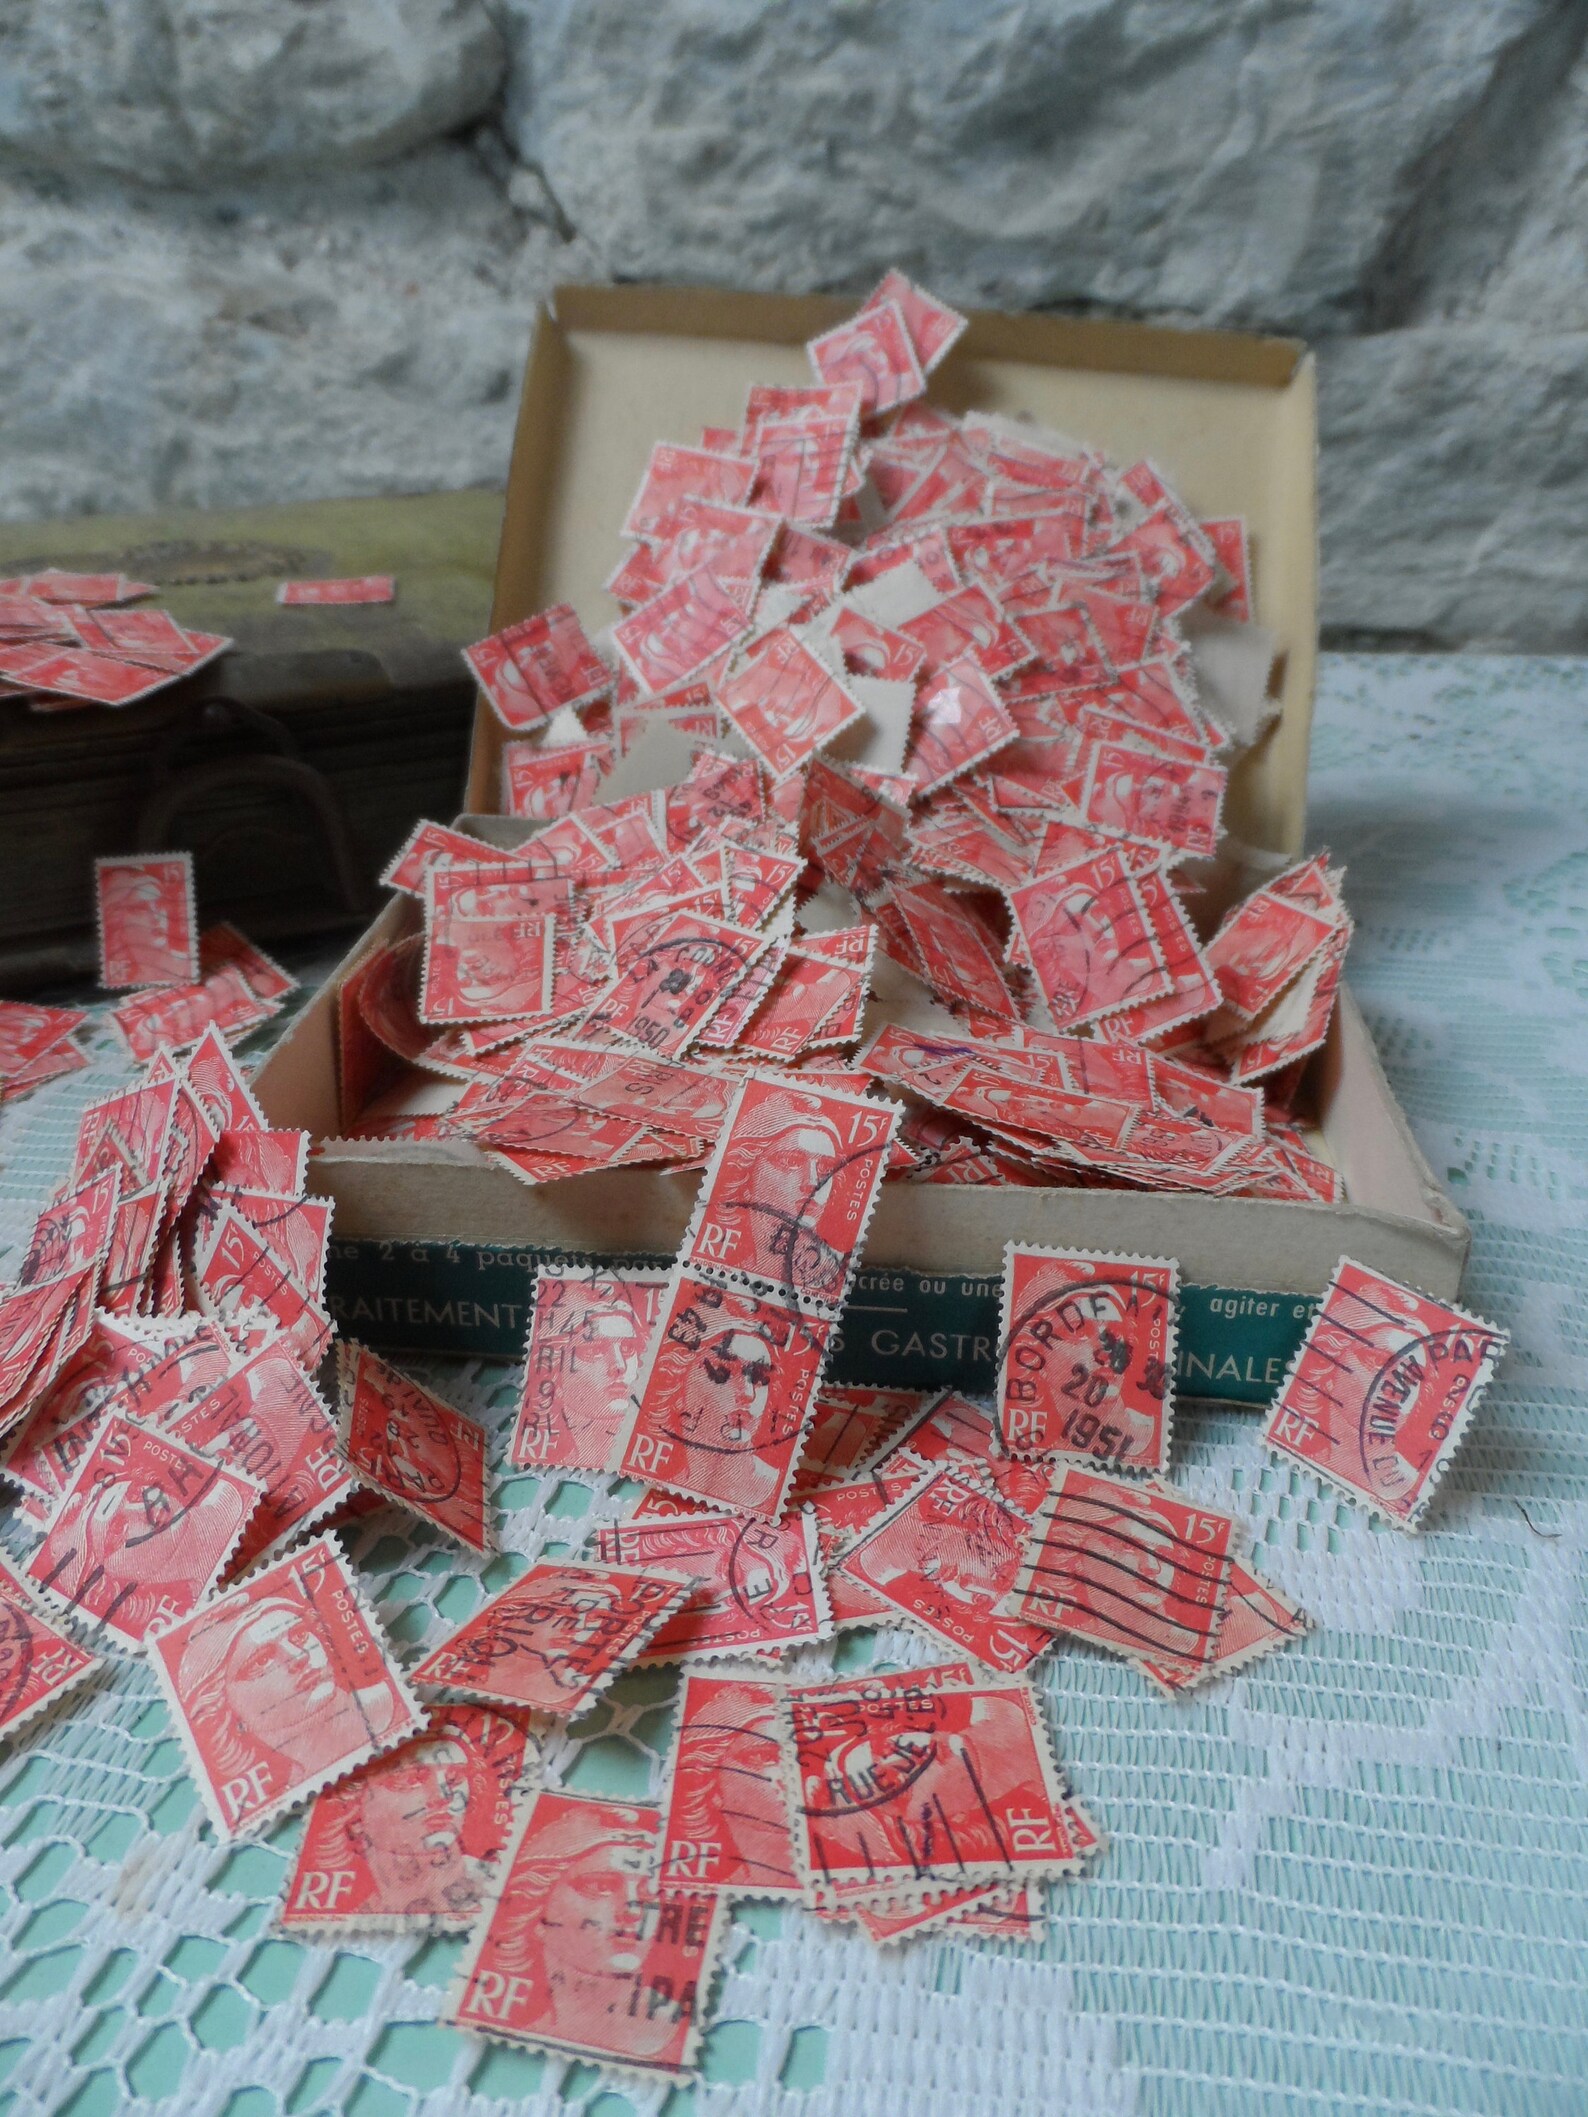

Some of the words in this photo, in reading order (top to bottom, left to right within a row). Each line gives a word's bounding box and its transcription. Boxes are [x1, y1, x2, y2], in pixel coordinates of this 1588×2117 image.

[846, 1157, 874, 1222] POSTES
[379, 1242, 396, 1262] 2
[446, 1247, 461, 1263] 4
[697, 1222, 743, 1261] RF
[852, 1273, 905, 1293] crée
[919, 1279, 947, 1296] ou
[961, 1281, 1002, 1298] une
[329, 1295, 523, 1330] RAITEMENT
[1208, 1295, 1280, 1320] agiter
[870, 1328, 996, 1363] GASTR
[1174, 1350, 1290, 1386] INALE
[1060, 1362, 1109, 1408] 20
[1007, 1408, 1049, 1443] RF
[1275, 1404, 1320, 1445] RF
[626, 1433, 675, 1473] RF
[836, 1482, 902, 1502] POSTS
[928, 1478, 972, 1518] RF
[1185, 1513, 1227, 1544] 15F
[330, 1588, 368, 1656] POSTES
[30, 1645, 86, 1687] RF
[219, 1762, 277, 1817] RF
[1005, 1806, 1056, 1853] RF
[667, 1839, 723, 1881] RF
[293, 1869, 358, 1912] RF
[463, 1967, 536, 2022] RF
